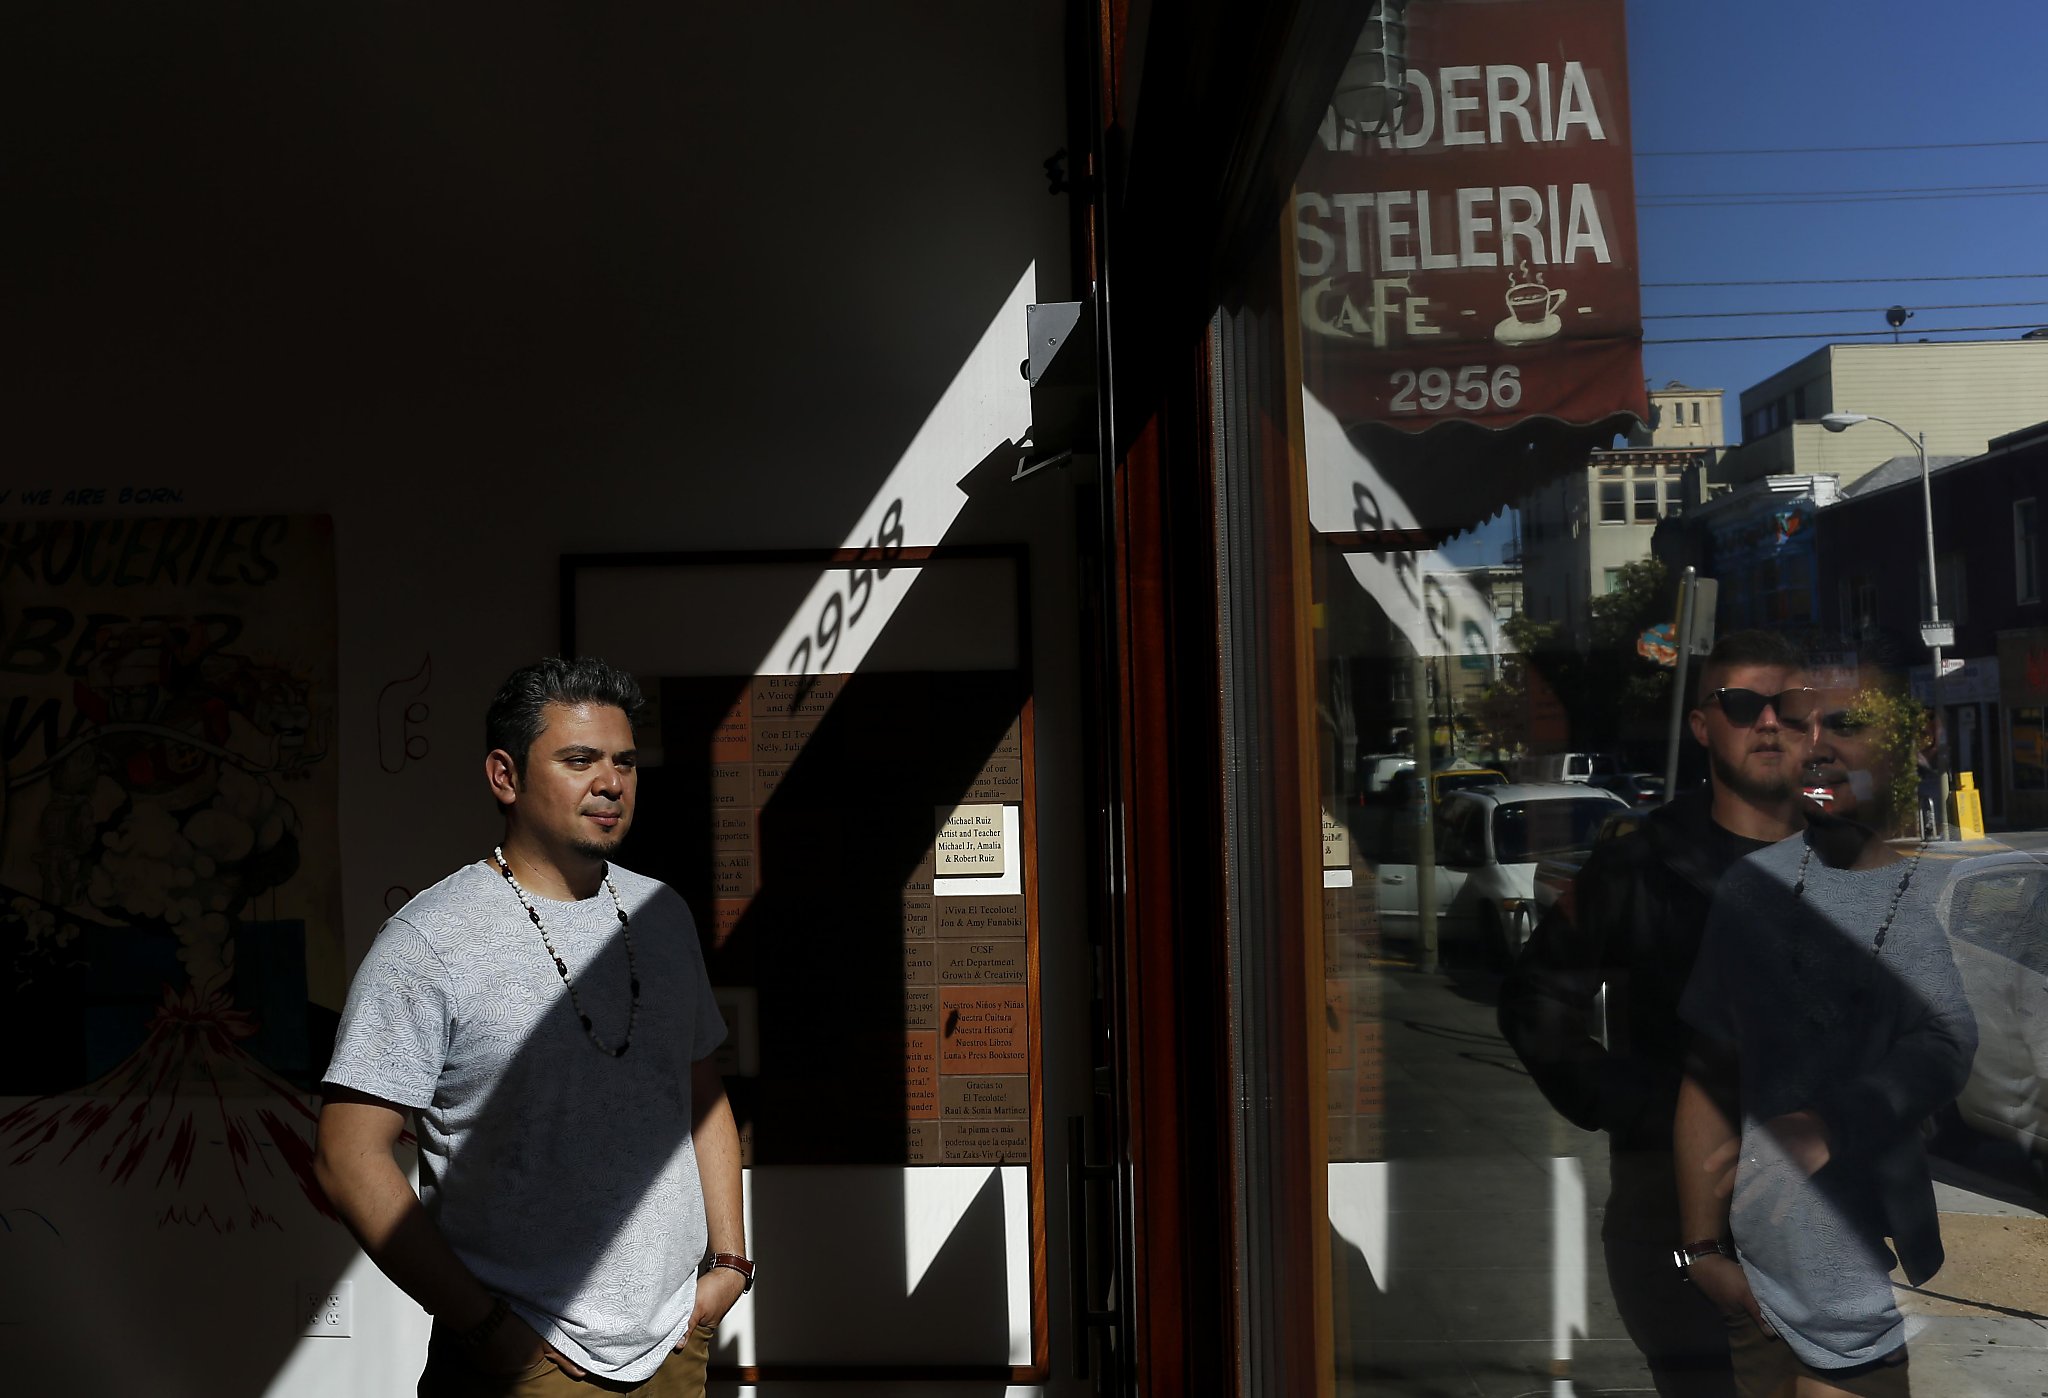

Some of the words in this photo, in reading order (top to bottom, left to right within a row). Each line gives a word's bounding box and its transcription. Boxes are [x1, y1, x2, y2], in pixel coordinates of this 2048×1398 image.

[1318, 62, 1606, 150] DERIA
[1297, 183, 1611, 276] STELERIA
[1390, 363, 1522, 412] 2956
[21, 489, 52, 505] WE
[62, 489, 106, 505] ARE
[769, 692, 793, 700] Voice
[809, 691, 833, 699] Truth
[948, 817, 973, 825] Michael
[976, 816, 991, 824] Ruiz
[974, 829, 1000, 837] Teacher
[939, 842, 964, 850] Michael
[967, 842, 975, 851] Jr,
[977, 841, 1001, 849] Amalia
[954, 854, 976, 862] Robert
[979, 854, 995, 862] Ruiz
[967, 920, 984, 928] Amy
[987, 918, 1022, 926] Funabiki
[970, 946, 994, 954] CCSF
[966, 959, 1014, 968] Department
[984, 971, 1023, 980] Creativity
[1004, 1000, 1024, 1008] Niñas
[985, 1026, 1013, 1034] Historia
[956, 1039, 987, 1047] Nuestros
[989, 1038, 1011, 1046] Libros
[969, 1051, 986, 1059] Press
[967, 1081, 993, 1090] Gracias
[905, 1090, 934, 1098] onzales
[905, 1103, 932, 1111] ounder
[972, 1106, 992, 1114] Sonia
[945, 1139, 976, 1148] poderosa
[978, 1140, 990, 1148] que
[1001, 1138, 1026, 1147] espada!
